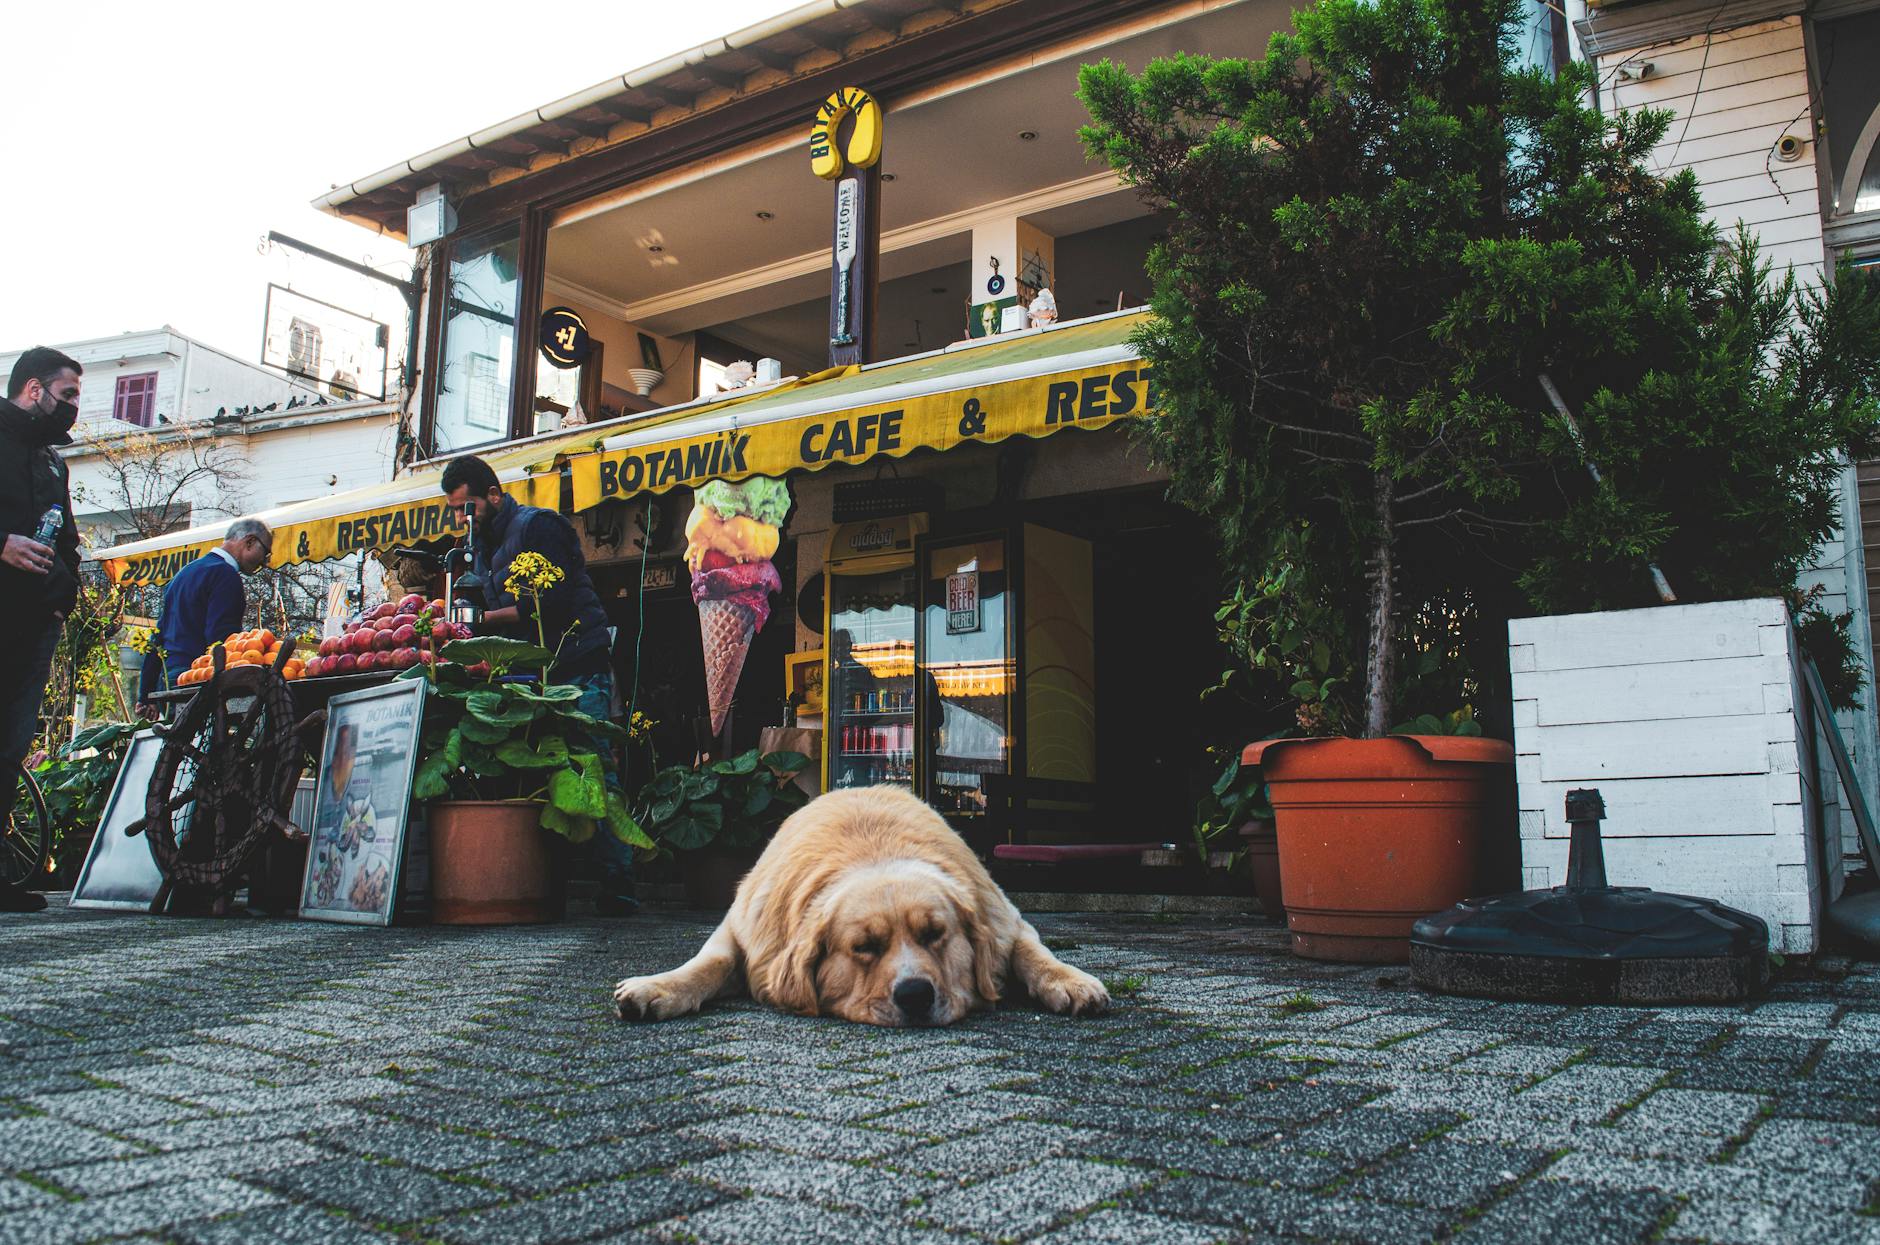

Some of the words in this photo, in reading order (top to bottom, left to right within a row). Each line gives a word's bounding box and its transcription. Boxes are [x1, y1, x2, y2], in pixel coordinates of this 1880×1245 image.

[555, 325, 577, 351] +1
[801, 409, 904, 464] CAFE
[958, 397, 987, 437] &
[297, 530, 310, 558] &
[337, 503, 465, 552] RESTAURA
[949, 576, 967, 592] COLD
[949, 590, 975, 611] BEER
[951, 612, 974, 629] HERE!
